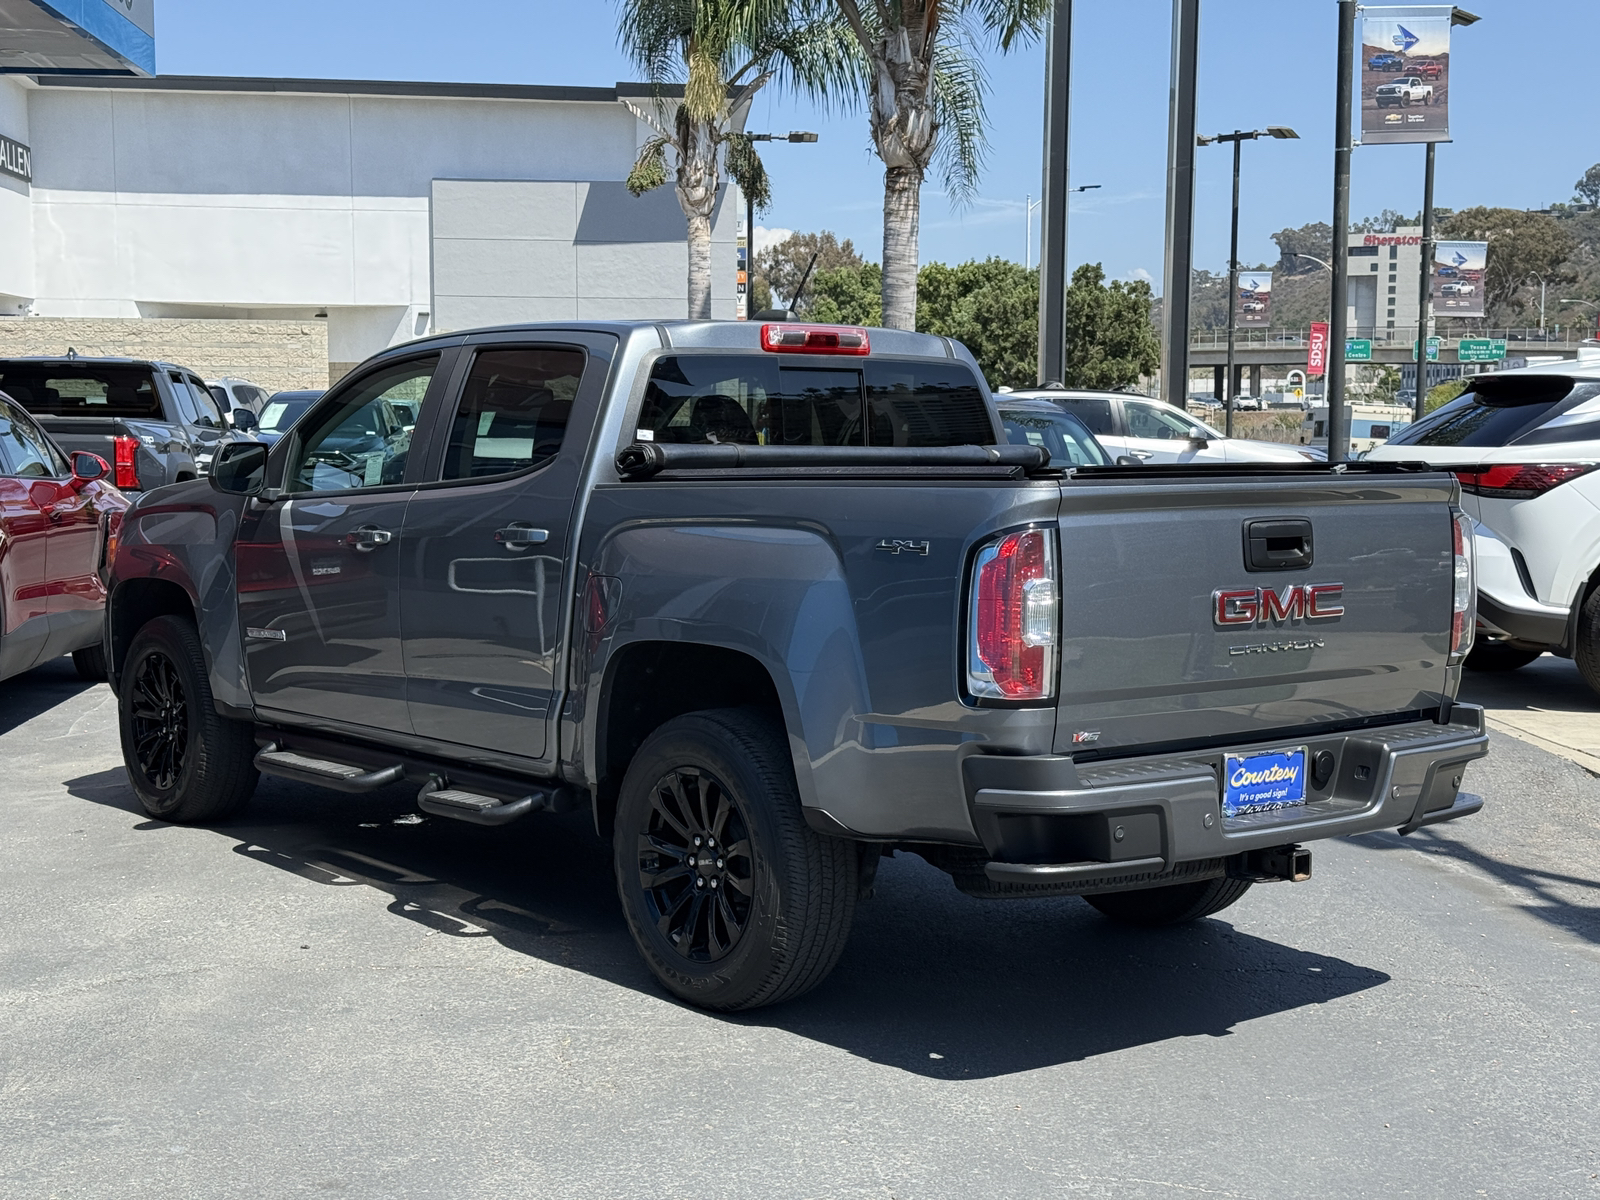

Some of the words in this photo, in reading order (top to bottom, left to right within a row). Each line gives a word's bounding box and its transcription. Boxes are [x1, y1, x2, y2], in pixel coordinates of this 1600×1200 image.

[0, 139, 32, 178] ALLEN
[1363, 234, 1422, 247] Sheraton
[1310, 333, 1324, 367] SDSU
[1211, 582, 1345, 626] GMC
[1229, 639, 1325, 655] CANYON
[1230, 763, 1299, 788] Courtesy
[1239, 793, 1249, 802] It's
[1255, 789, 1273, 802] good
[1273, 787, 1289, 799] sign!
